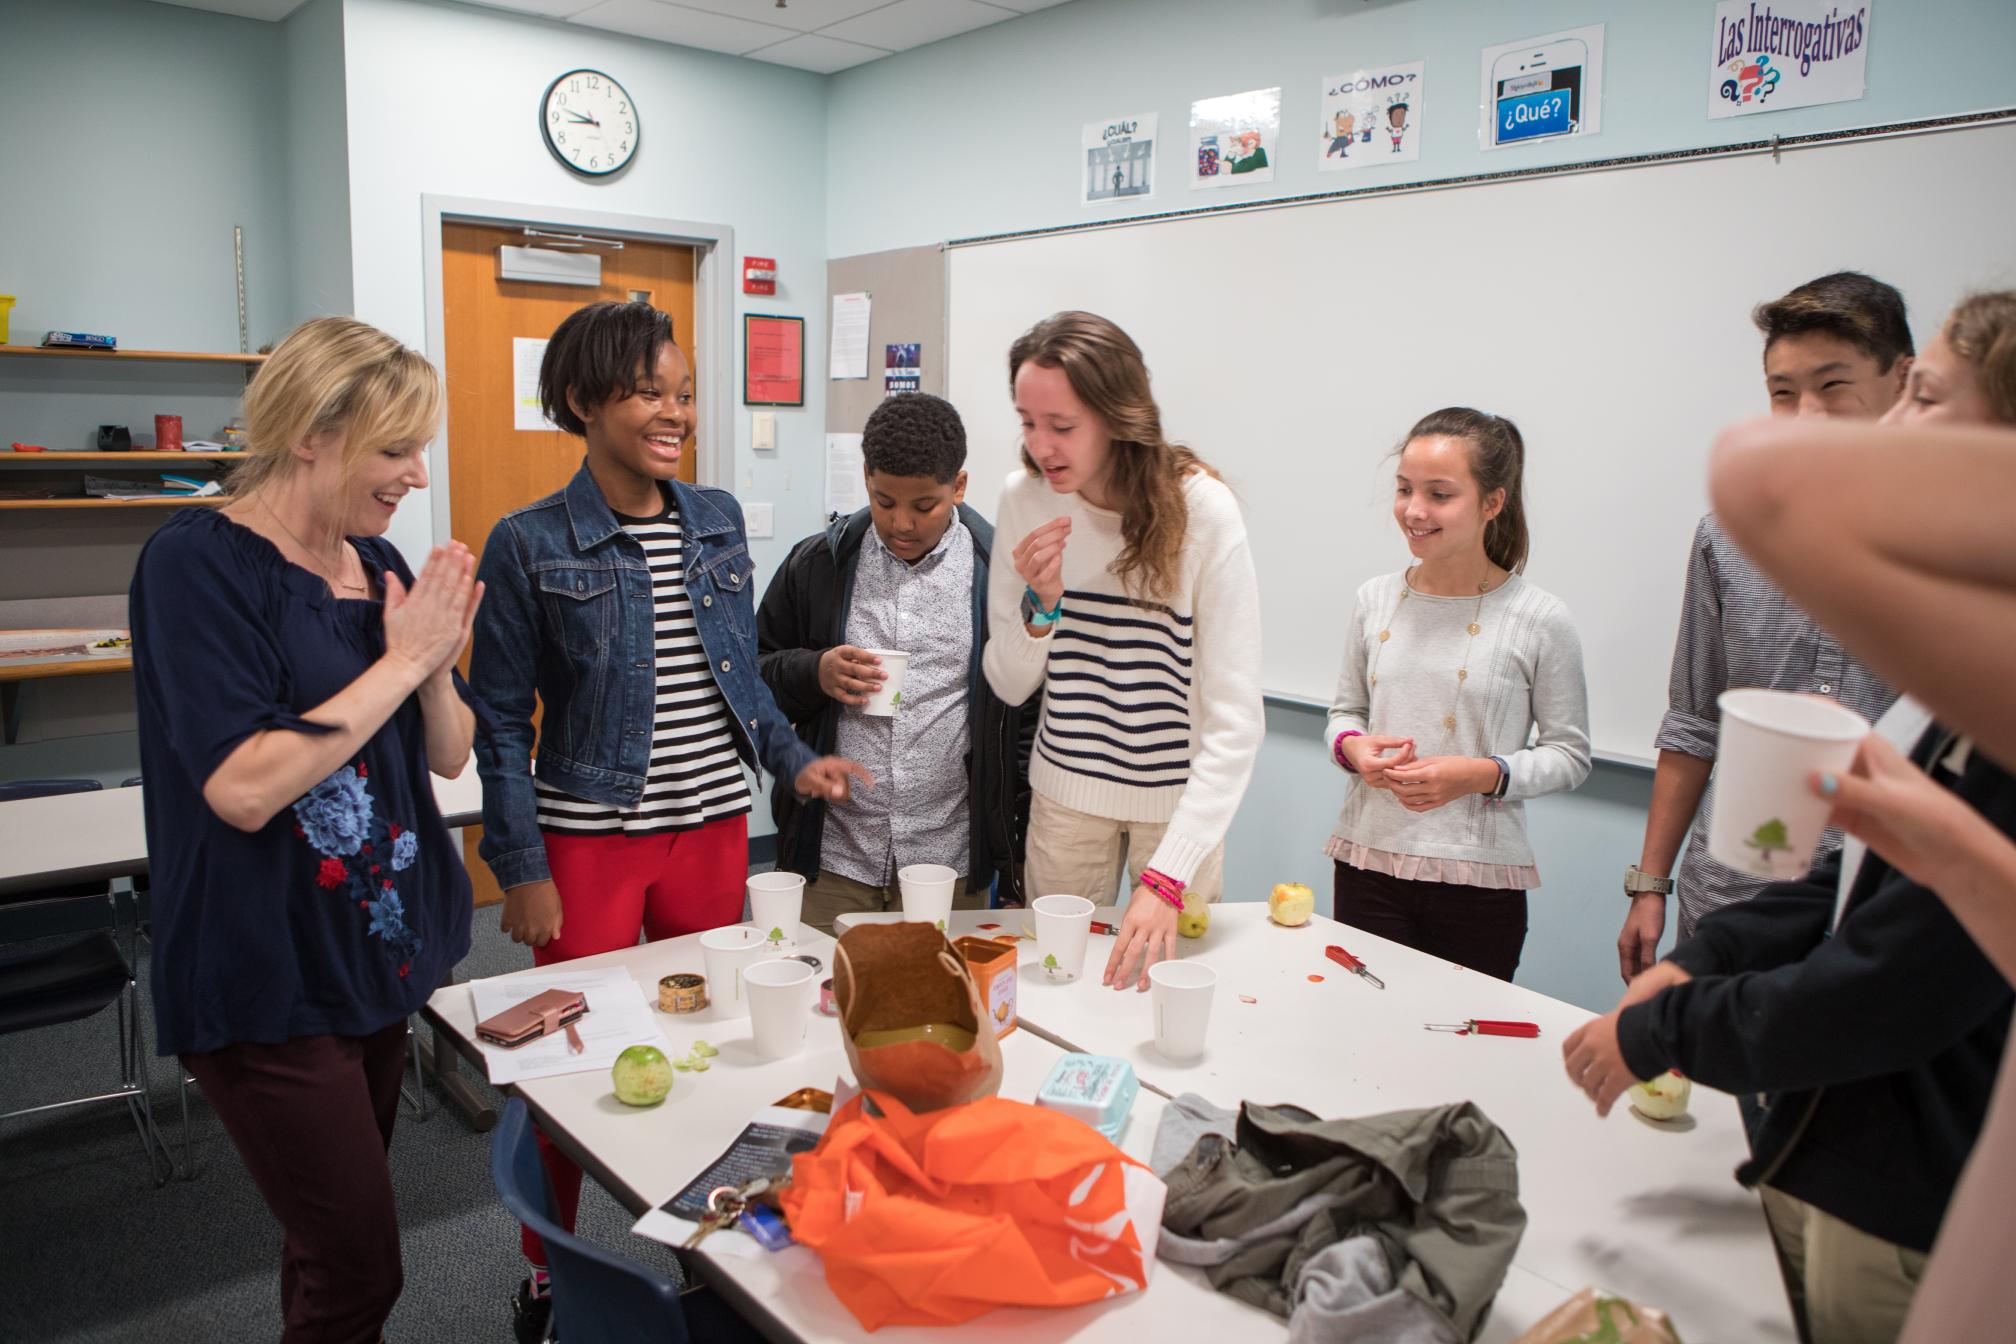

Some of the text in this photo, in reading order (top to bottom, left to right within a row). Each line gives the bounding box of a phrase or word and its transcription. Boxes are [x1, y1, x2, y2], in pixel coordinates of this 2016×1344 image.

[1718, 3, 1865, 77] Las Interrogativas
[571, 79, 580, 93] 11
[586, 76, 600, 90] 12
[619, 101, 627, 115] 2
[1505, 98, 1561, 130] ¿Qué?
[552, 111, 560, 124] 9
[625, 121, 632, 134] 3
[557, 131, 566, 144] 8
[620, 140, 627, 152] 4
[573, 148, 581, 161] 7
[607, 153, 615, 166] 5
[590, 155, 598, 168] 6
[752, 260, 769, 268] FIRE
[889, 381, 916, 389] SOMOS
